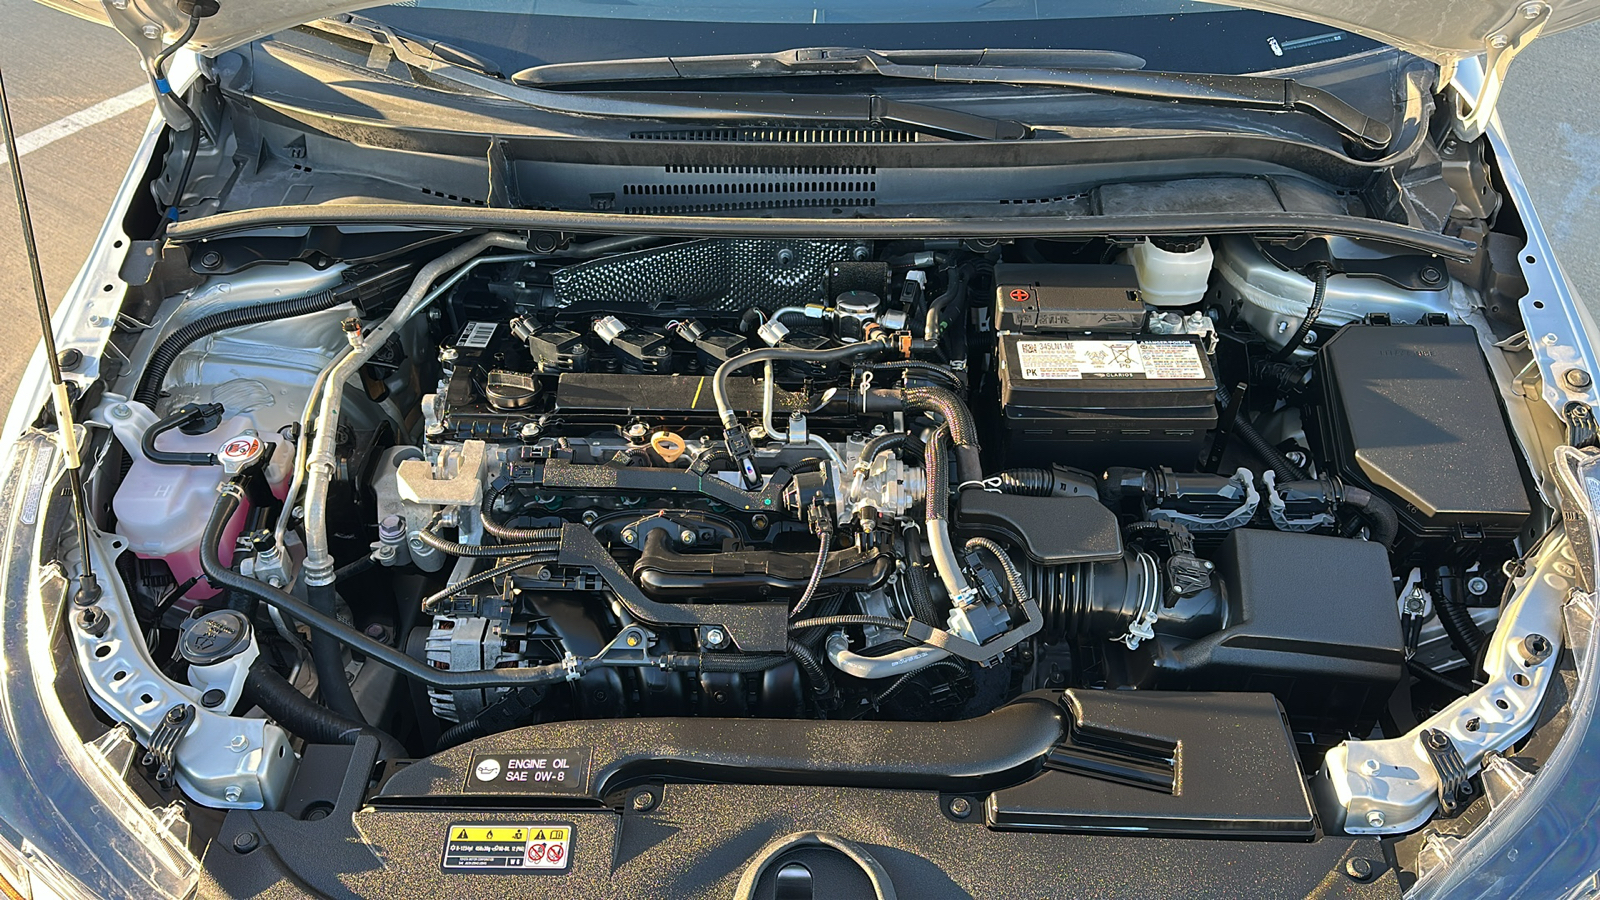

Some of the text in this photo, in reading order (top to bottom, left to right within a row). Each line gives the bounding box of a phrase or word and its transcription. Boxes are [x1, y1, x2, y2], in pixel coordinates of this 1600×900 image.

[1026, 368, 1038, 376] PK
[508, 758, 570, 769] ENGINE OIL
[506, 772, 565, 782] SAE 0W-8
